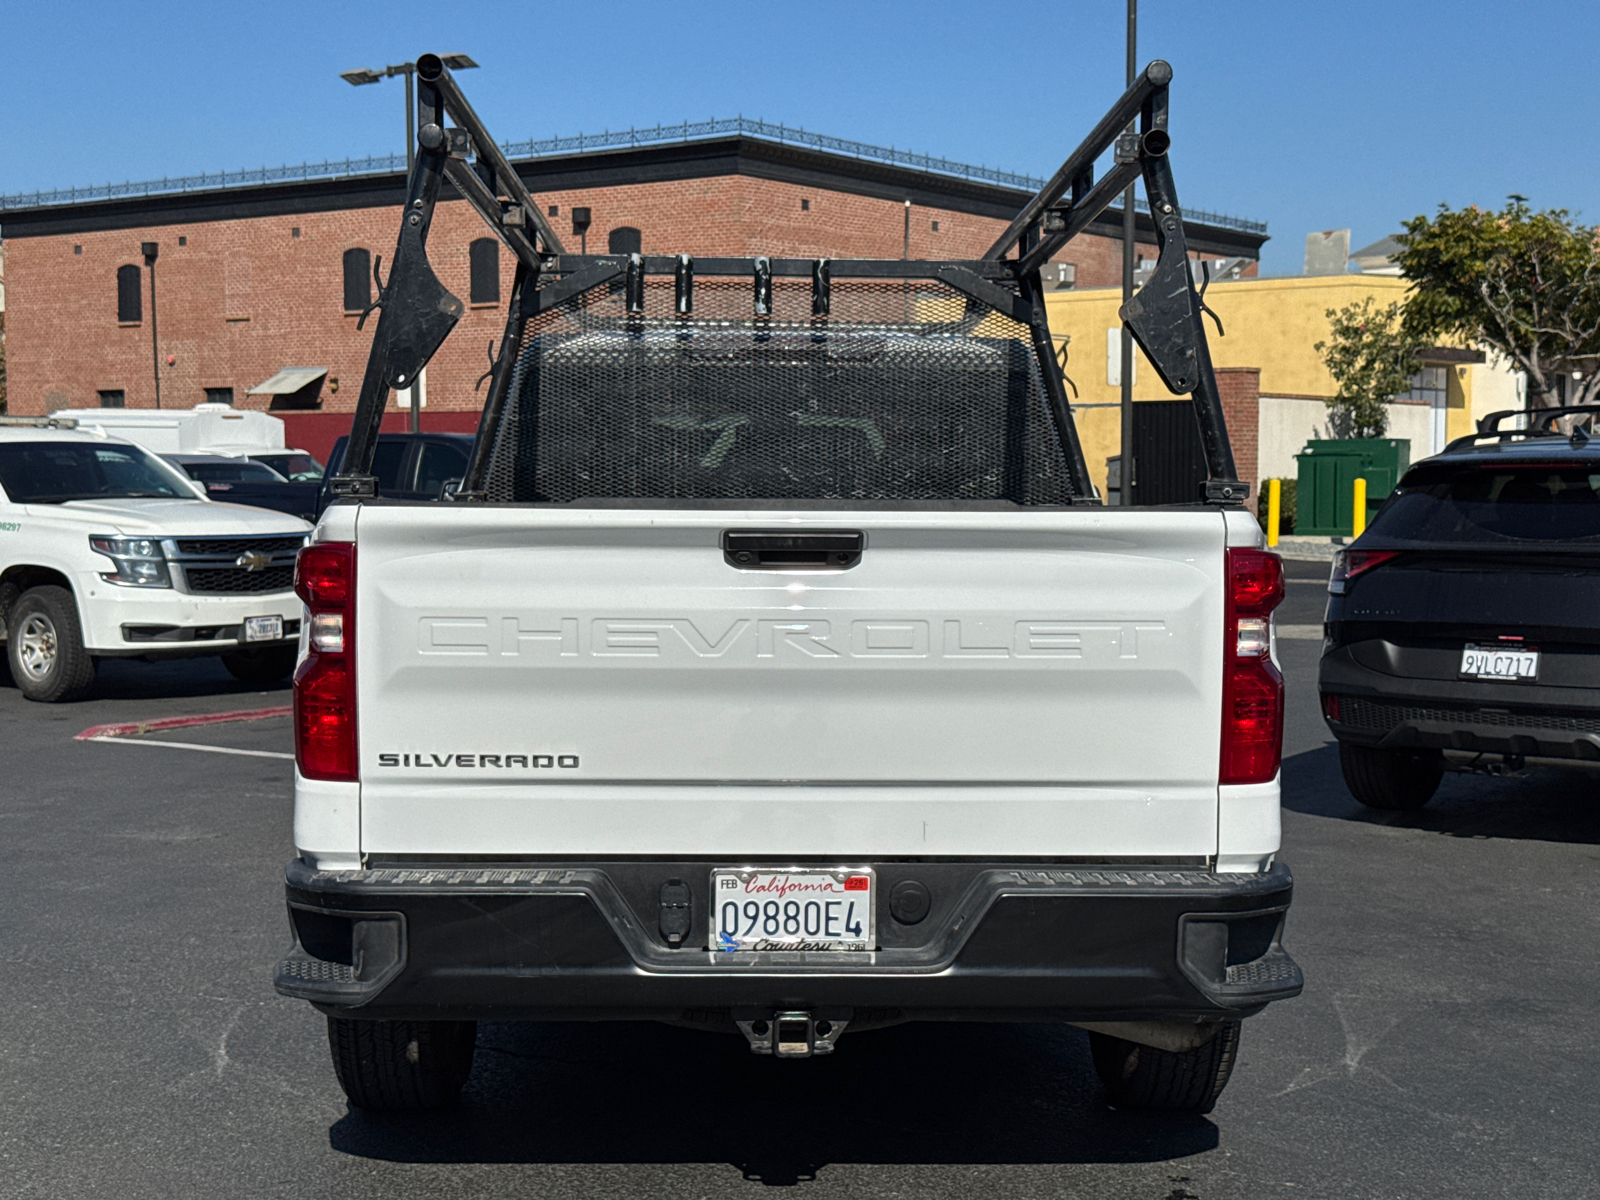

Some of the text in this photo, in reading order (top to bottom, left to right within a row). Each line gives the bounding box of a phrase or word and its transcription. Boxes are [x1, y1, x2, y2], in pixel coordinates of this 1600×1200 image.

[417, 616, 1167, 660] CHEVROLET
[1464, 655, 1534, 676] 9VLC717
[378, 753, 580, 768] SILVERADO
[721, 879, 738, 889] FEB
[745, 874, 845, 898] California
[721, 900, 863, 937] 09880E4
[753, 938, 833, 951] Courtesy
